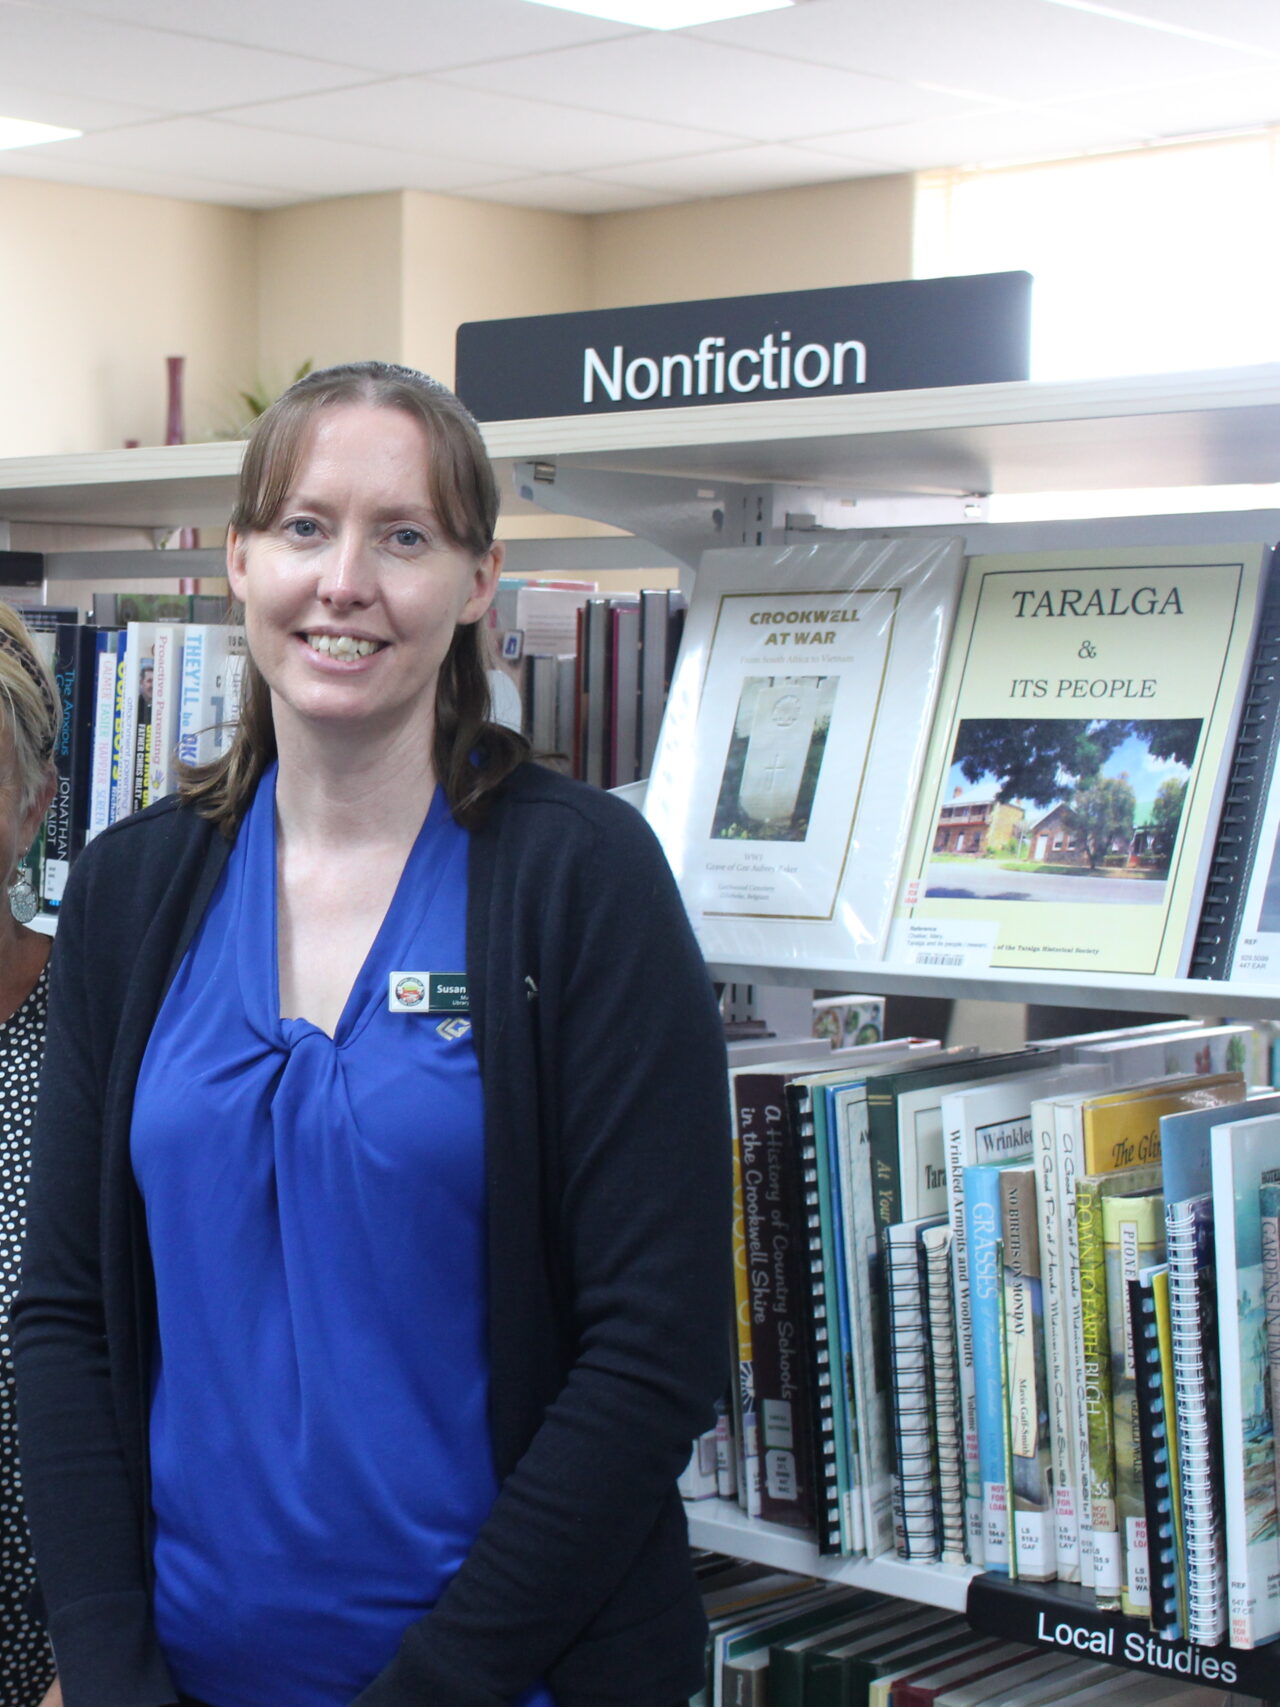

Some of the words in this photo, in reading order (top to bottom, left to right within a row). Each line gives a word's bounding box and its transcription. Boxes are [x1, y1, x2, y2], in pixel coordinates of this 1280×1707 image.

[583, 331, 866, 403] Nonfiction
[749, 609, 860, 625] CROOKWELL
[1012, 586, 1184, 618] TARALGA
[764, 632, 791, 646] AT
[794, 631, 837, 645] WAR
[1077, 638, 1098, 660] &
[157, 635, 168, 698] Proactive
[183, 634, 203, 706] THEY'LL
[821, 654, 854, 663] Vietnam
[63, 669, 75, 697] The
[101, 660, 113, 699] CALMER
[1009, 679, 1048, 699] ITS
[1055, 678, 1158, 699] PEOPLE
[61, 699, 74, 757] Anxious
[100, 703, 111, 738] EASIER
[125, 697, 133, 758] attachment
[137, 723, 146, 751] FATHER
[152, 701, 165, 765] Parenting
[182, 711, 193, 727] be
[97, 742, 110, 785] HAPPIER
[136, 752, 145, 776] CHRIS
[121, 760, 131, 809] parenting
[47, 797, 58, 846] HAIDT
[57, 776, 70, 861] JONATHAN
[95, 789, 107, 825] SCREEN
[1018, 944, 1040, 953] Taralga
[1041, 945, 1074, 953] Historical
[1075, 947, 1099, 956] Society
[436, 984, 466, 994] Susan
[741, 1107, 756, 1128] in
[742, 1131, 763, 1164] the
[765, 1127, 783, 1204] History
[949, 1129, 964, 1193] Wrinkled
[1112, 1137, 1135, 1168] The
[877, 1160, 892, 1180] At
[925, 1164, 947, 1190] Tara
[1042, 1155, 1053, 1192] Good
[879, 1189, 893, 1223] Your
[1008, 1187, 1018, 1207] NO
[1046, 1197, 1056, 1231] Pair
[745, 1169, 768, 1266] Crookwell
[770, 1209, 789, 1232] of
[952, 1196, 967, 1255] Armpits
[1008, 1209, 1021, 1257] BIRTHS
[1076, 1193, 1094, 1259] DOWN
[972, 1202, 998, 1299] GRASSES
[1011, 1258, 1022, 1278] ON
[1262, 1222, 1280, 1304] GARDENS
[772, 1235, 789, 1314] Country
[957, 1257, 969, 1283] and
[1048, 1249, 1058, 1294] Hands
[1079, 1264, 1096, 1293] TO
[751, 1269, 770, 1324] Shire
[1012, 1282, 1025, 1336] MONDAY
[1064, 1157, 1075, 1195] Good
[1070, 1252, 1079, 1297] Hands
[1079, 1439, 1088, 1471] Shire
[959, 1287, 973, 1368] Woollybutts
[1082, 1298, 1099, 1356] EARTH
[1266, 1308, 1280, 1326] IN
[777, 1321, 798, 1399] Schools
[1019, 1378, 1027, 1405] Mavis
[1085, 1362, 1101, 1415] BLIGH
[966, 1394, 976, 1432] Volume
[1056, 1435, 1066, 1468] Shire
[1134, 1540, 1148, 1548] LOA
[1037, 1612, 1115, 1656] Local
[1124, 1632, 1238, 1684] Studies
